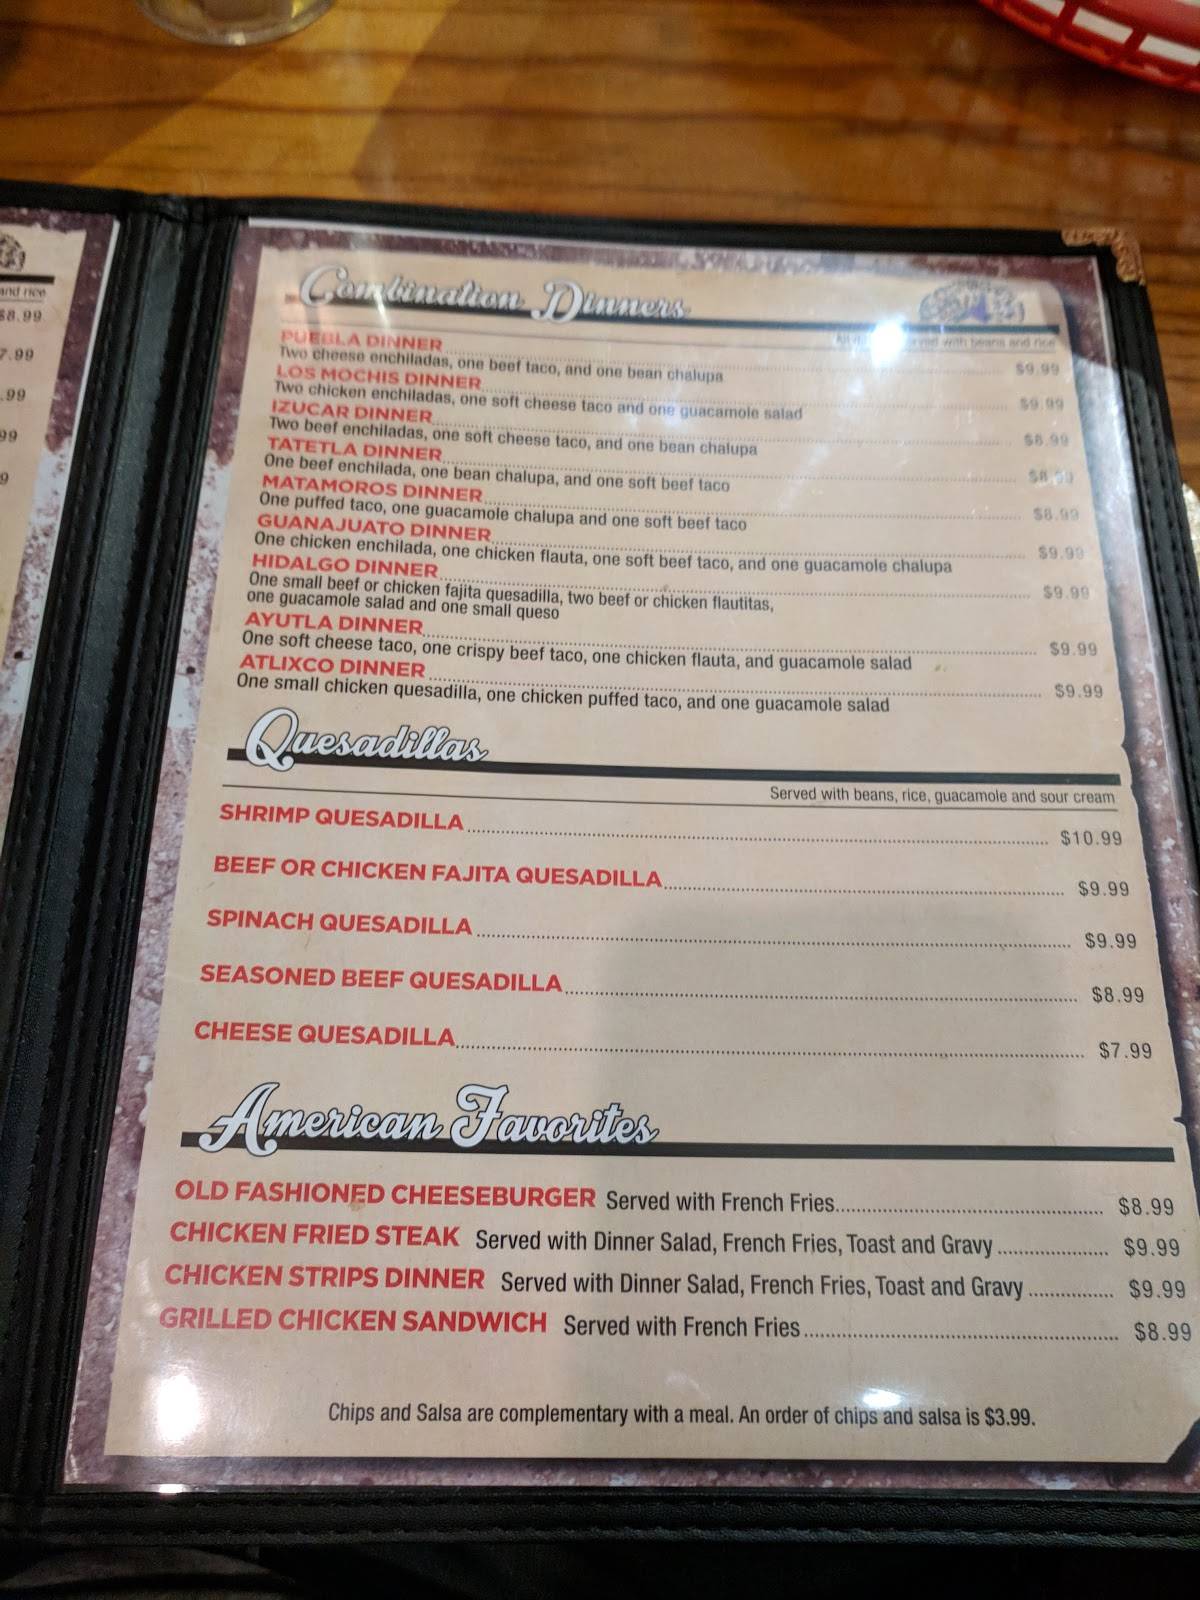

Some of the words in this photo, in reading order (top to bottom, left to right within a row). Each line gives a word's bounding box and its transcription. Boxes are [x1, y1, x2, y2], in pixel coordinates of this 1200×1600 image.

[23, 287, 46, 298] rice
[301, 265, 524, 311] Combination
[530, 279, 692, 324] Dinners
[277, 330, 361, 347] PUEBLA
[364, 335, 443, 351] DINNER
[1014, 363, 1061, 377] $9.99
[1034, 338, 1056, 350] rice
[274, 365, 317, 380] LOS
[318, 368, 400, 385] MOCHIS
[402, 373, 481, 390] DINNER
[269, 400, 350, 417] IZUCAR
[351, 405, 432, 422] DINNER
[266, 438, 358, 456] TATETLA
[361, 443, 442, 461] DINNER
[258, 491, 290, 506] One
[293, 493, 344, 513] puffed
[349, 497, 387, 515] taco,
[391, 503, 420, 515] one
[424, 502, 509, 524] guacamole
[513, 507, 574, 527] chalupa
[579, 511, 606, 525] and
[611, 515, 639, 527] one
[644, 514, 672, 528] soft
[677, 515, 710, 530] beef
[714, 517, 747, 531] taco
[260, 474, 397, 497] MATAMOROS
[402, 484, 483, 502] DINNER
[1032, 507, 1080, 522] $8.99
[256, 513, 406, 536] GUANAJUATO
[408, 522, 491, 540] DINNER
[1036, 545, 1085, 560] $9.99
[250, 554, 351, 573] HIDALGO
[353, 559, 438, 578] DINNER
[1041, 584, 1090, 600] $9.99
[246, 590, 274, 603] one
[278, 589, 360, 611] guacamole
[364, 593, 404, 610] salad
[409, 596, 436, 612] and
[440, 601, 468, 614] one
[472, 600, 511, 616] small
[516, 606, 559, 623] queso
[243, 611, 334, 630] AYUTLA
[336, 616, 423, 635] DINNER
[1048, 640, 1098, 656] $9.99
[235, 672, 269, 689] One
[273, 675, 319, 692] small
[323, 678, 388, 696] chicken
[392, 681, 481, 704] quesadilla,
[486, 689, 515, 702] one
[521, 687, 582, 705] chicken
[588, 690, 638, 710] puffed
[644, 692, 681, 710] taco,
[686, 693, 715, 709] and
[720, 697, 749, 710] one
[755, 695, 842, 715] guacamole
[847, 697, 889, 712] salad
[239, 653, 336, 673] ATLIXCO
[337, 659, 425, 678] DINNER
[1053, 682, 1104, 699] $9.99
[244, 706, 489, 772] Quesadillas
[769, 784, 816, 800] Served
[820, 785, 849, 800] with
[853, 786, 898, 803] beans,
[901, 787, 930, 804] rice,
[933, 787, 1008, 806] guacamole
[1010, 788, 1036, 803] and
[1039, 792, 1069, 804] sour
[1072, 792, 1115, 804] cream
[218, 804, 311, 824] SHRIMP
[314, 808, 463, 831] QUESADILLA
[1059, 829, 1123, 846] $10.99
[211, 855, 276, 874] BEEF
[278, 858, 317, 876] OR
[320, 859, 426, 880] CHICKEN
[430, 863, 511, 882] FAJITA
[514, 866, 661, 888] QUESADILLA
[1077, 879, 1129, 897] $9.99
[205, 909, 314, 930] SPINACH
[318, 913, 472, 936] QUESADILLA
[1084, 931, 1137, 950] $9.99
[199, 964, 337, 986] SEASONED
[340, 968, 404, 988] BEEF
[407, 970, 562, 992] QUESADILLA
[1090, 985, 1145, 1004] $8.99
[192, 1021, 293, 1042] CHEESE
[296, 1024, 456, 1047] QUESADILLA
[1098, 1041, 1153, 1060] $7.99
[198, 1081, 444, 1157] American
[450, 1083, 660, 1149] Favorites
[173, 1180, 230, 1201] OLD
[233, 1181, 386, 1204] FASHIONED
[389, 1184, 596, 1208] CHEESEBURGER
[606, 1188, 669, 1210] Served
[675, 1189, 714, 1211] with
[722, 1190, 783, 1211] French
[790, 1191, 835, 1212] Fries
[1117, 1196, 1175, 1216] $8.99
[168, 1221, 287, 1244] CHICKEN
[292, 1224, 370, 1246] FRIED
[374, 1225, 459, 1248] STEAK
[476, 1227, 540, 1250] Served
[547, 1228, 586, 1251] with
[594, 1229, 654, 1252] Dinner
[660, 1230, 716, 1256] Salad,
[723, 1231, 785, 1253] French
[792, 1232, 842, 1257] Fries,
[845, 1233, 895, 1254] Toast
[900, 1233, 935, 1254] and
[940, 1233, 994, 1260] Gravy
[1122, 1237, 1181, 1258] $9.99
[162, 1263, 283, 1286] CHICKEN
[286, 1265, 380, 1288] STRIPS
[384, 1267, 484, 1290] DINNER
[501, 1269, 566, 1292] Served
[573, 1270, 613, 1293] with
[620, 1271, 681, 1294] Dinner
[687, 1272, 744, 1298] Salad,
[750, 1273, 813, 1295] French
[820, 1273, 871, 1299] Fries,
[874, 1274, 925, 1296] Toast
[929, 1274, 965, 1296] and
[970, 1275, 1024, 1302] Gravy
[1128, 1278, 1186, 1299] $9.99
[158, 1306, 273, 1330] GRILLED
[276, 1308, 397, 1331] CHICKEN
[400, 1310, 548, 1333] SANDWICH
[563, 1312, 629, 1335] Served
[636, 1313, 676, 1335] with
[684, 1313, 747, 1336] French
[754, 1314, 800, 1336] Fries
[1133, 1320, 1192, 1342] $8.99
[327, 1399, 375, 1427] Chips
[379, 1399, 411, 1421] and
[416, 1399, 462, 1421] Salsa
[467, 1404, 493, 1421] are
[499, 1400, 628, 1427] complementary
[633, 1400, 668, 1422] with
[673, 1405, 684, 1422] a
[689, 1401, 733, 1423] meal.
[737, 1401, 759, 1423] An
[765, 1401, 808, 1423] order
[813, 1401, 830, 1423] of
[833, 1402, 878, 1429] chips
[882, 1402, 913, 1424] and
[917, 1403, 961, 1425] salsa
[965, 1403, 980, 1425] is
[983, 1403, 1035, 1426] $3.99.
